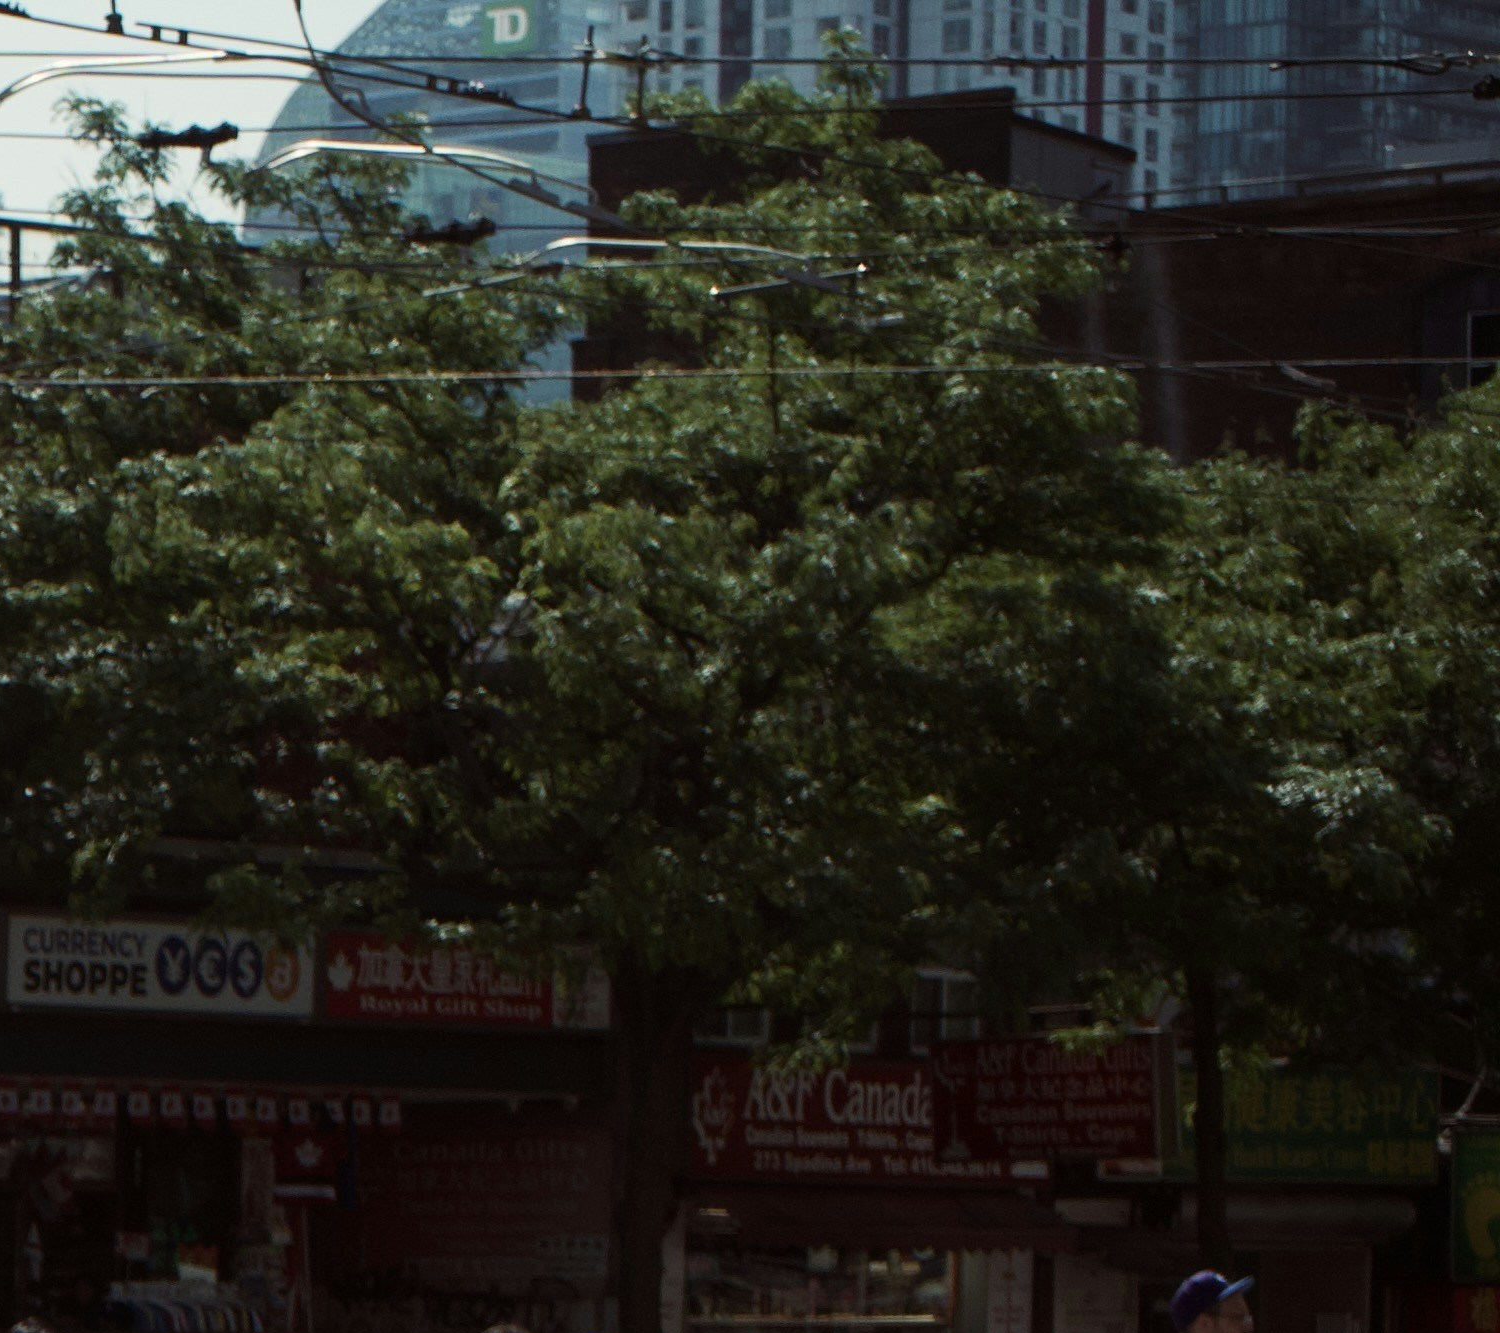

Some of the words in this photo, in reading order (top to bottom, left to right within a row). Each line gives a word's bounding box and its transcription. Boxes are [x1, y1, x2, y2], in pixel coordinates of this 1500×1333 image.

[486, 7, 528, 43] TD
[23, 927, 146, 957] CURRENCY
[24, 959, 148, 996] SHOPPE
[358, 992, 429, 1016] Royal
[434, 994, 477, 1016] Gift
[484, 997, 542, 1022] Shop
[743, 1068, 816, 1122] A&F
[977, 1103, 1058, 1124] Canadian
[1065, 1101, 1150, 1122] Souvenirs
[1086, 1123, 1135, 1144] Caps
[784, 1151, 842, 1174] Spadina
[845, 1155, 872, 1174] Ave
